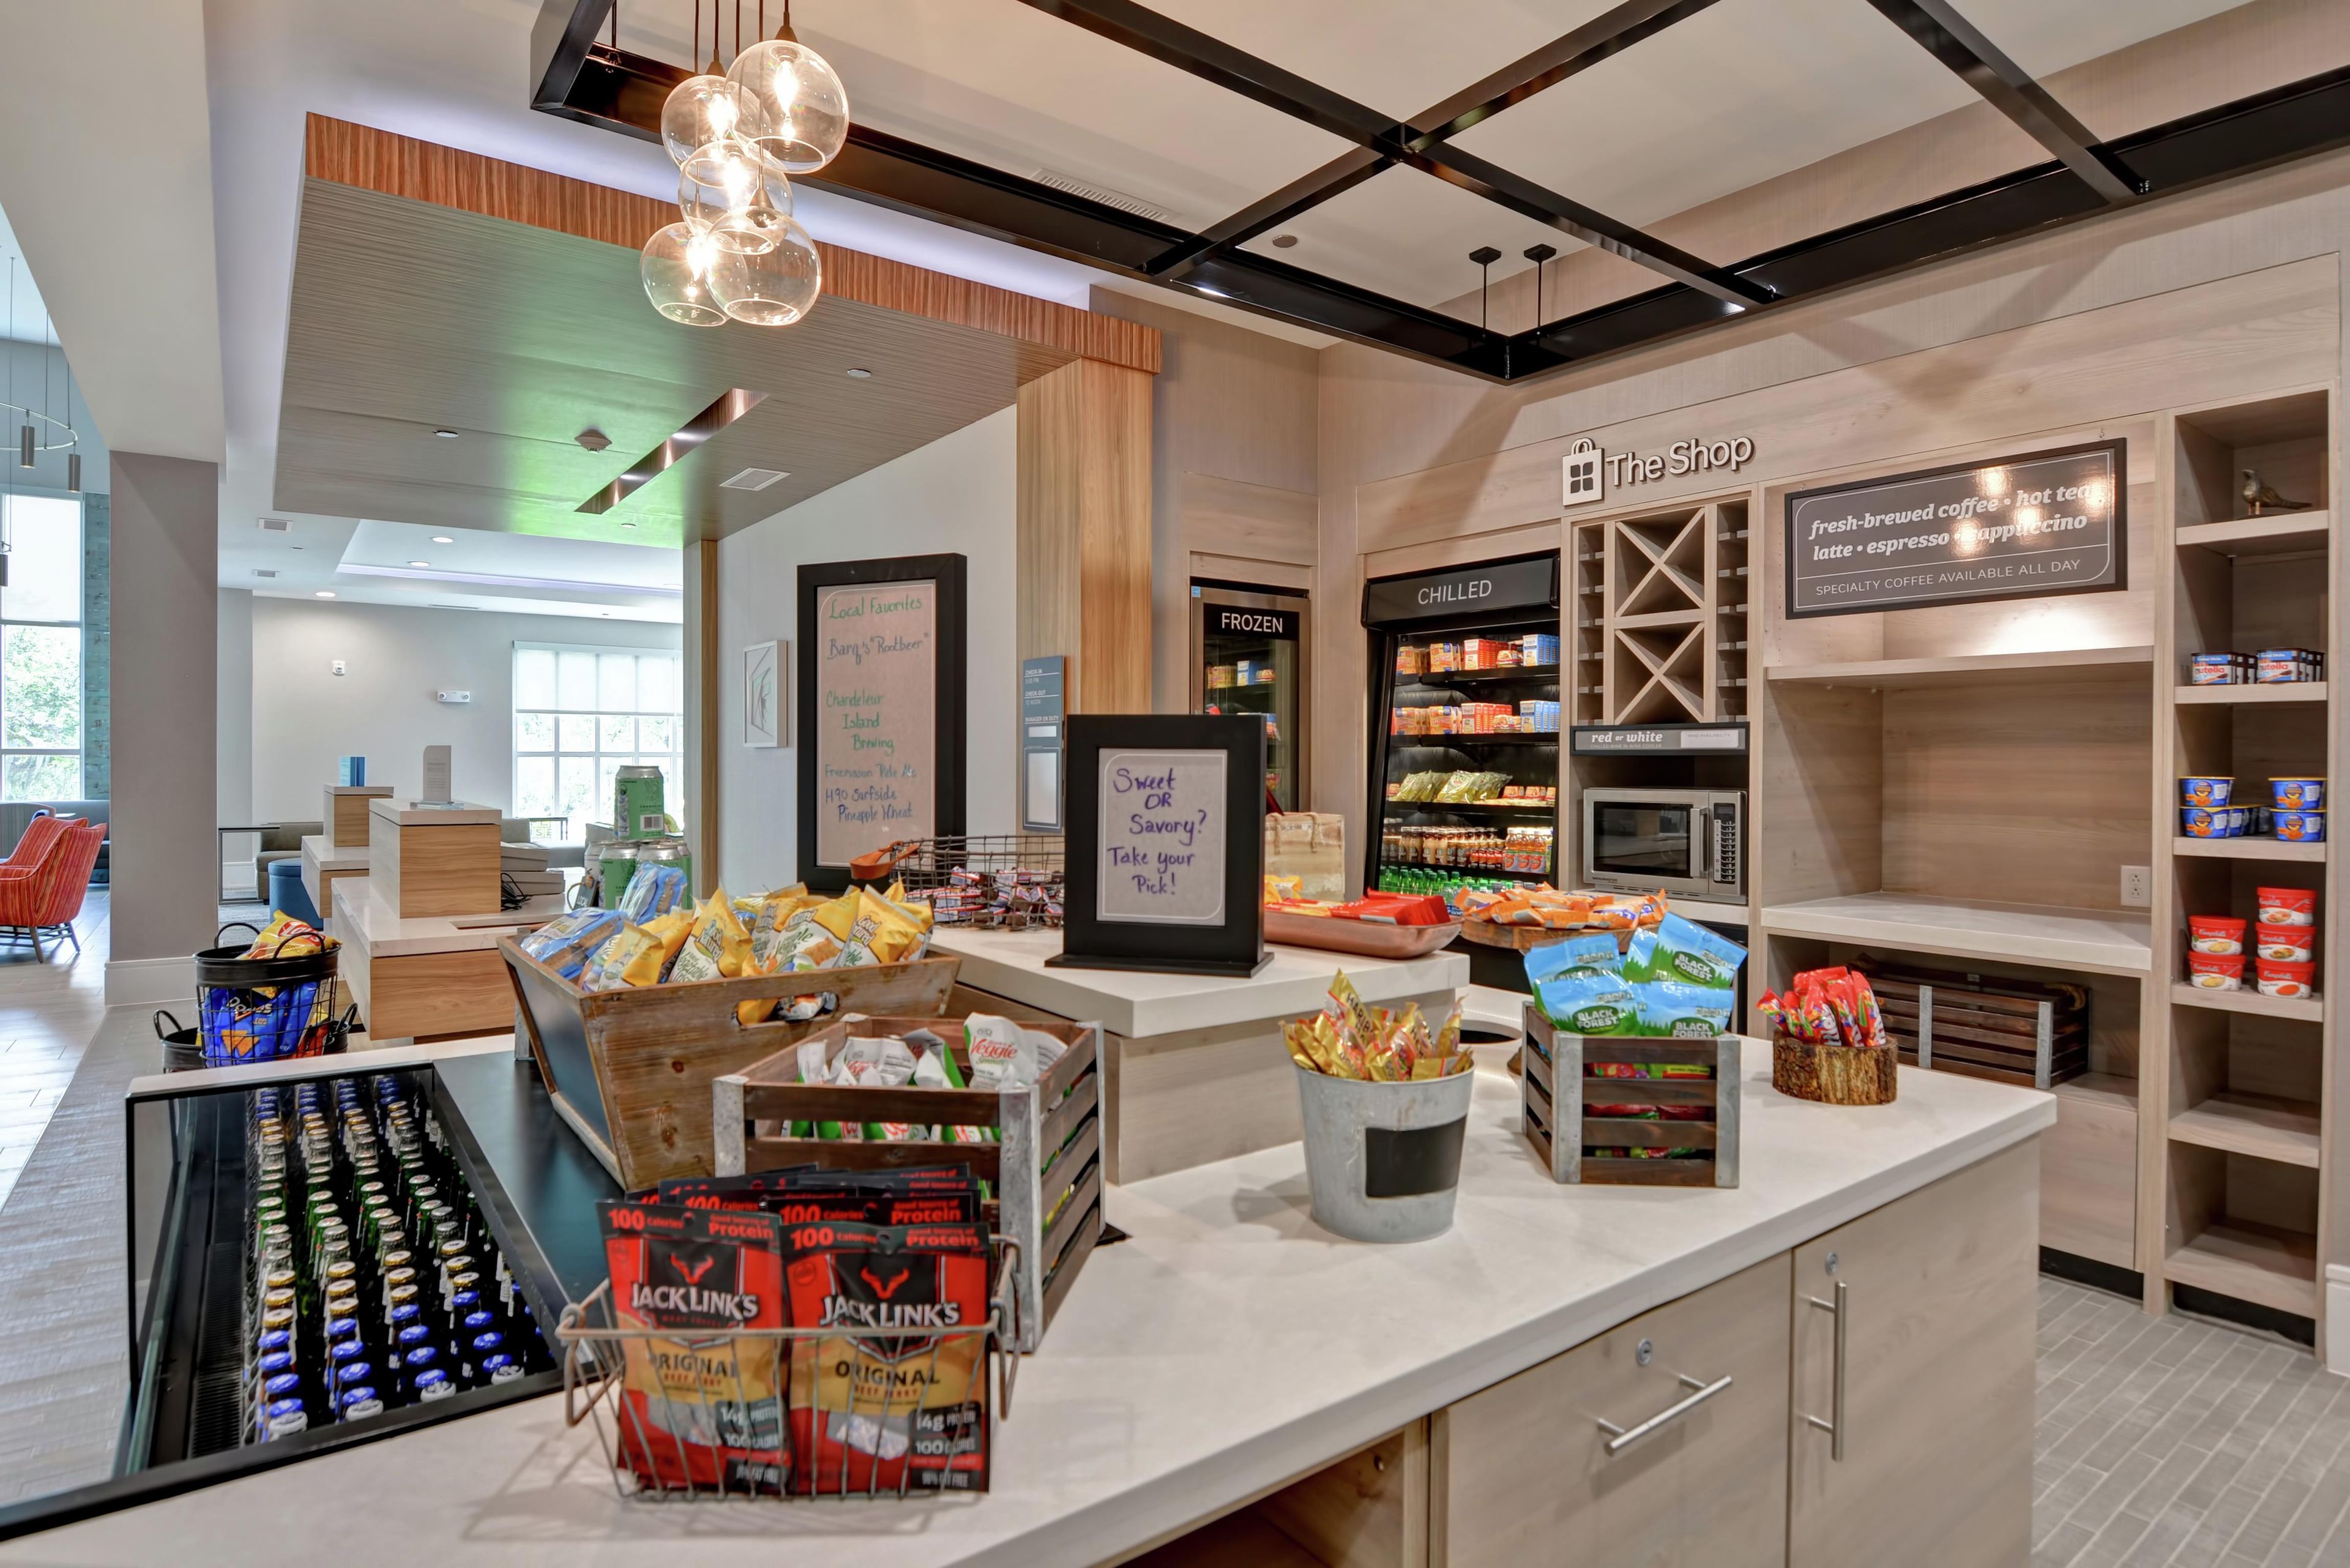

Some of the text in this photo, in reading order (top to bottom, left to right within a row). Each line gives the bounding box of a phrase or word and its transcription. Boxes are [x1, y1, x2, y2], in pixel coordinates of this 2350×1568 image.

[1605, 436, 1754, 487] The Shop
[1808, 485, 2092, 540] fresh-brewed coffee hot tea
[1813, 513, 2087, 561] latte espresso appuccino
[1816, 559, 2081, 596] SPECIALTY COFFEE AVAILABLE ALL DAY
[1417, 579, 1493, 605] CHILLED
[829, 594, 923, 619] Local Favorites
[1221, 612, 1283, 633] FROZEN
[841, 711, 881, 729] Island
[851, 734, 895, 756] Brewing
[1591, 731, 1613, 743] red
[1625, 730, 1663, 742] white
[1113, 767, 1176, 793] Sweet
[1144, 791, 1172, 810] OR
[837, 804, 878, 824] Pineapple
[1129, 809, 1207, 846] Savory?
[1107, 846, 1195, 875] Take your
[1132, 872, 1176, 895] Pick!
[857, 915, 881, 935] Good
[1674, 959, 1713, 982] FOREST
[1678, 953, 1712, 974] BLACK
[1346, 991, 1373, 1034] HARIB
[1576, 1017, 1619, 1029] FOREST
[1577, 1009, 1614, 1021] BLACK
[1675, 1021, 1710, 1032] BLACK
[970, 1036, 1018, 1059] Veggie
[608, 1208, 646, 1231] 100
[779, 1204, 822, 1226] 100
[891, 1208, 962, 1226] Protein
[708, 1222, 774, 1240] Protein
[790, 1226, 878, 1250] 100 Calories
[906, 1234, 980, 1247] Protein
[631, 1282, 759, 1321] JACK LINK'S
[819, 1295, 961, 1329] JACK LINK'S
[649, 1353, 740, 1378] RIGINA
[915, 1439, 944, 1455] 100
